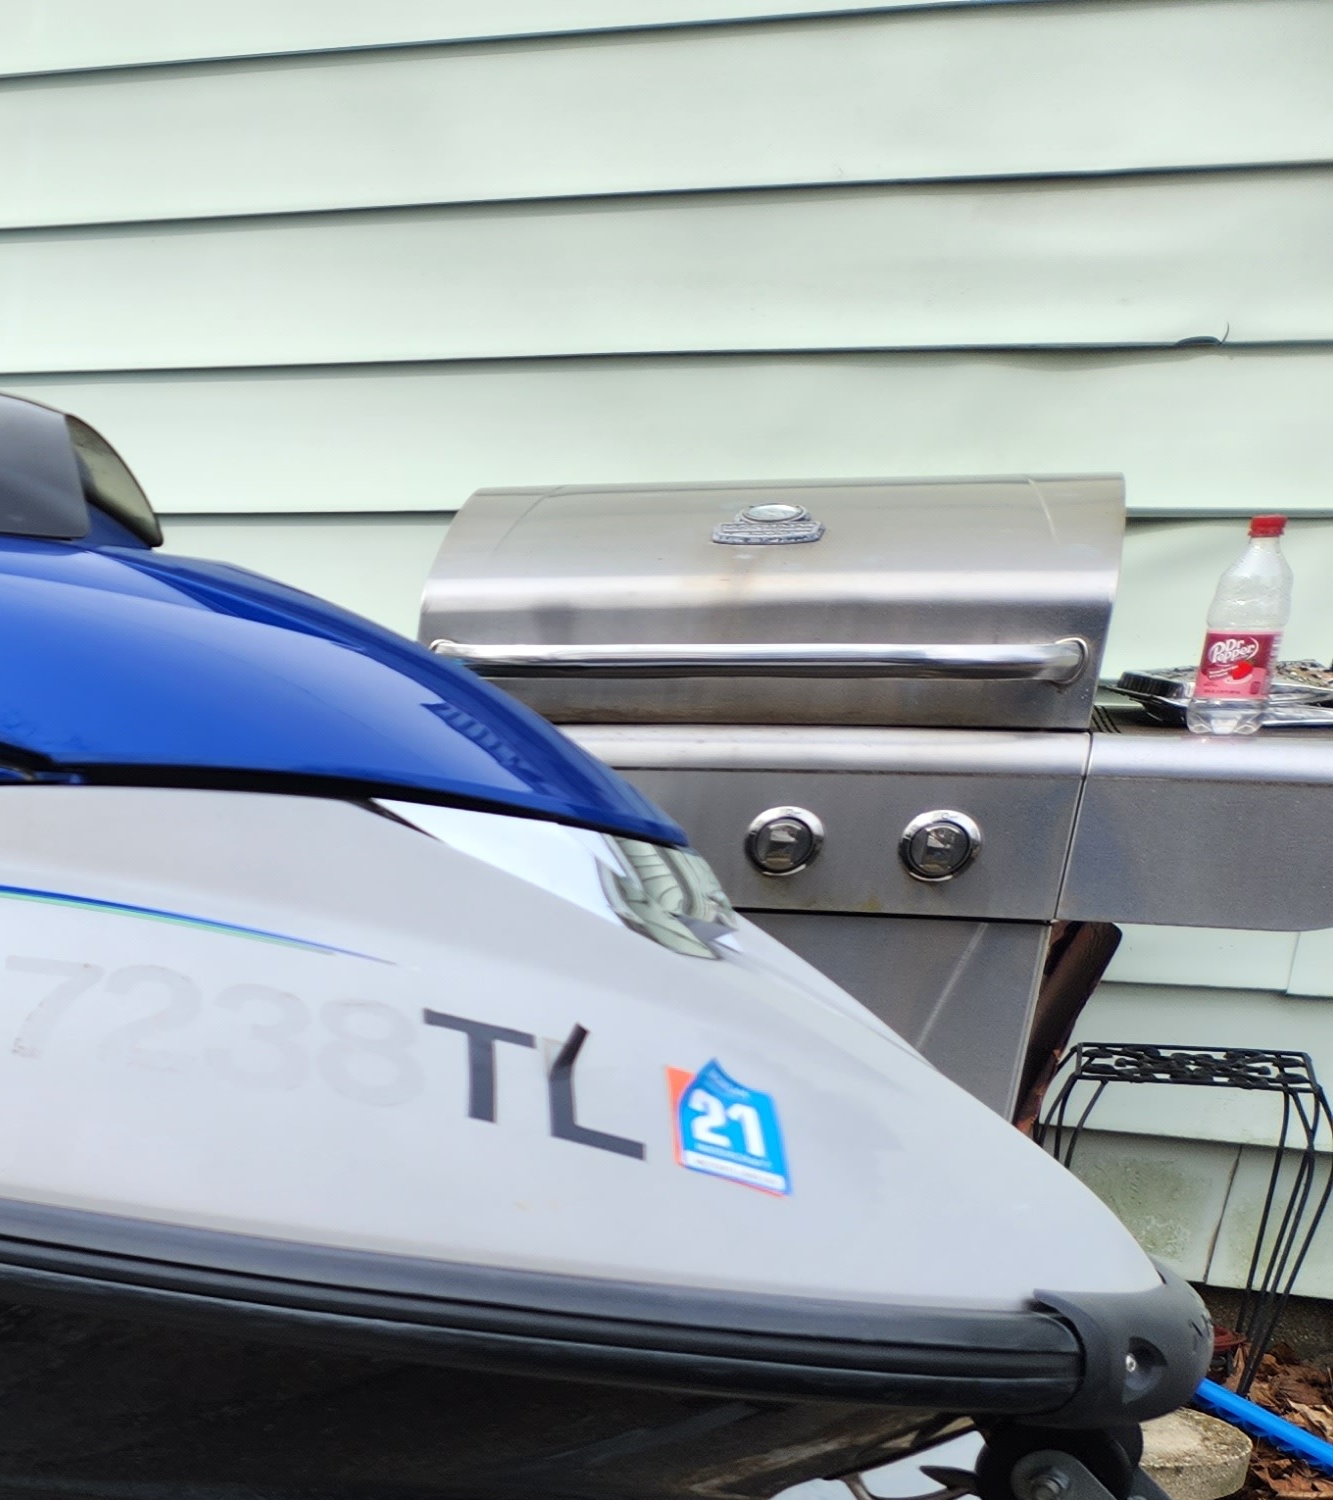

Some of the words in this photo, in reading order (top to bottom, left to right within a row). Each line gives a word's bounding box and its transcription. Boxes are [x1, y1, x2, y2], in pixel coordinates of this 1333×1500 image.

[1210, 642, 1256, 664] Pepper
[1225, 638, 1245, 651] Dr
[423, 1007, 646, 1160] TL
[687, 1088, 767, 1158] 21
